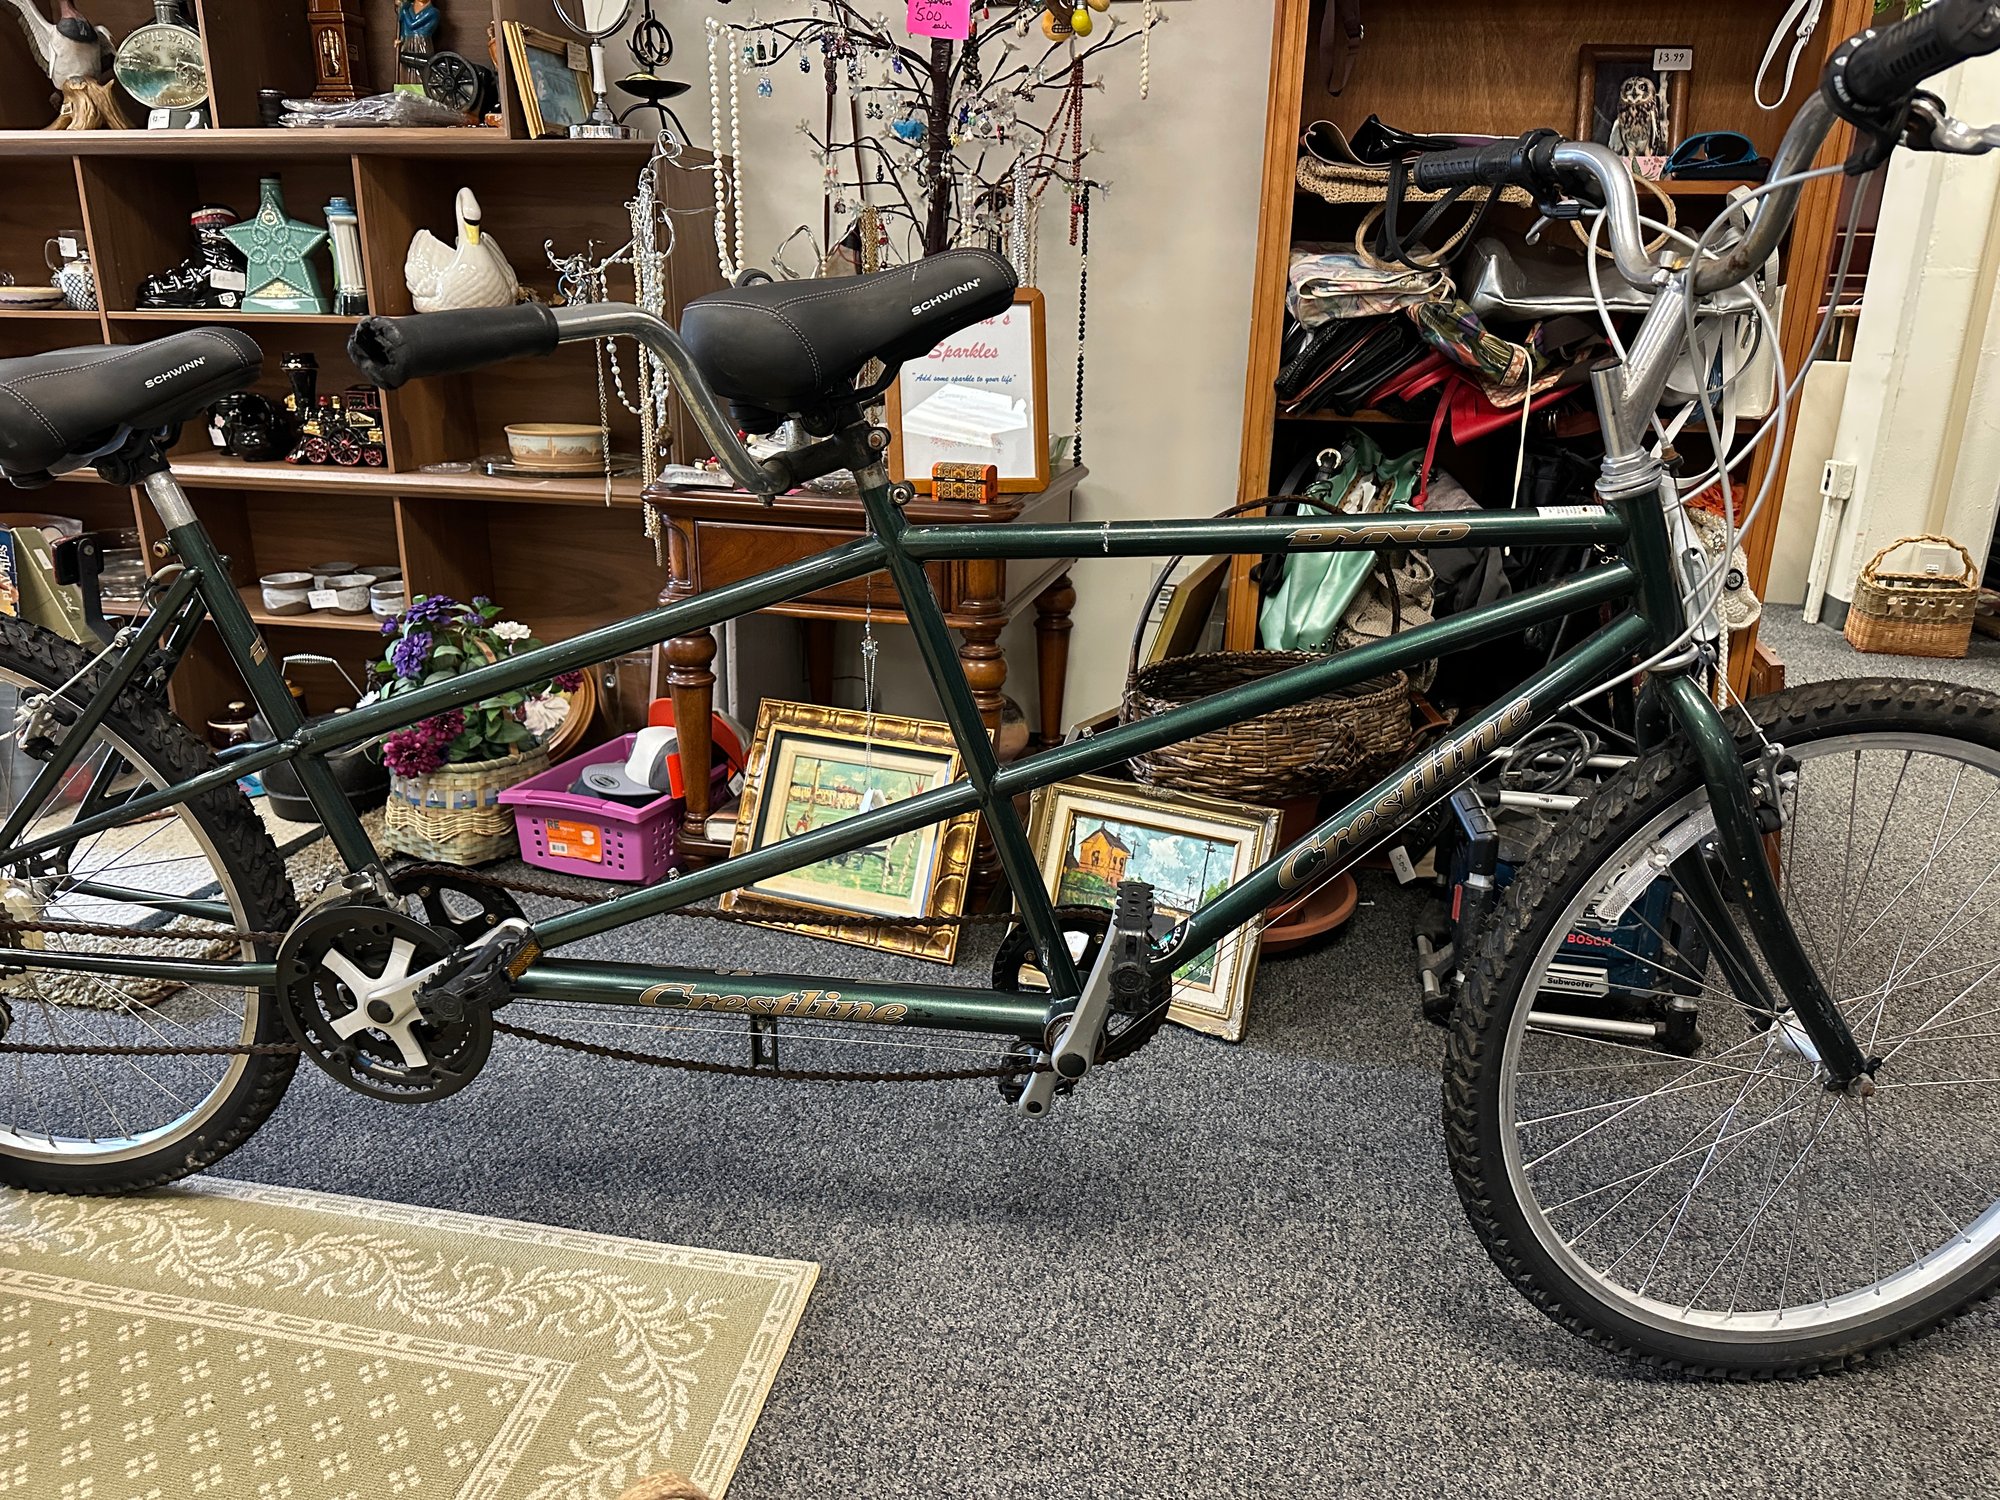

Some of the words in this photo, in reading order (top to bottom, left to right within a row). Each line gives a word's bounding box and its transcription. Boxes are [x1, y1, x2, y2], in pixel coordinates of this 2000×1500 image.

[932, 21, 953, 29] each
[1659, 51, 1685, 64] $3.99
[911, 278, 980, 316] SCHWINN
[928, 341, 999, 362] Sparkles
[144, 356, 205, 389] SCHWINN
[951, 374, 975, 384] sparkle
[985, 376, 999, 384] your
[1285, 523, 1472, 547] DYNO
[1278, 697, 1533, 890] Crestline
[1567, 934, 1612, 947] BOSCH
[1547, 977, 1594, 993] Subwoofer
[638, 983, 908, 1024] Crestline
